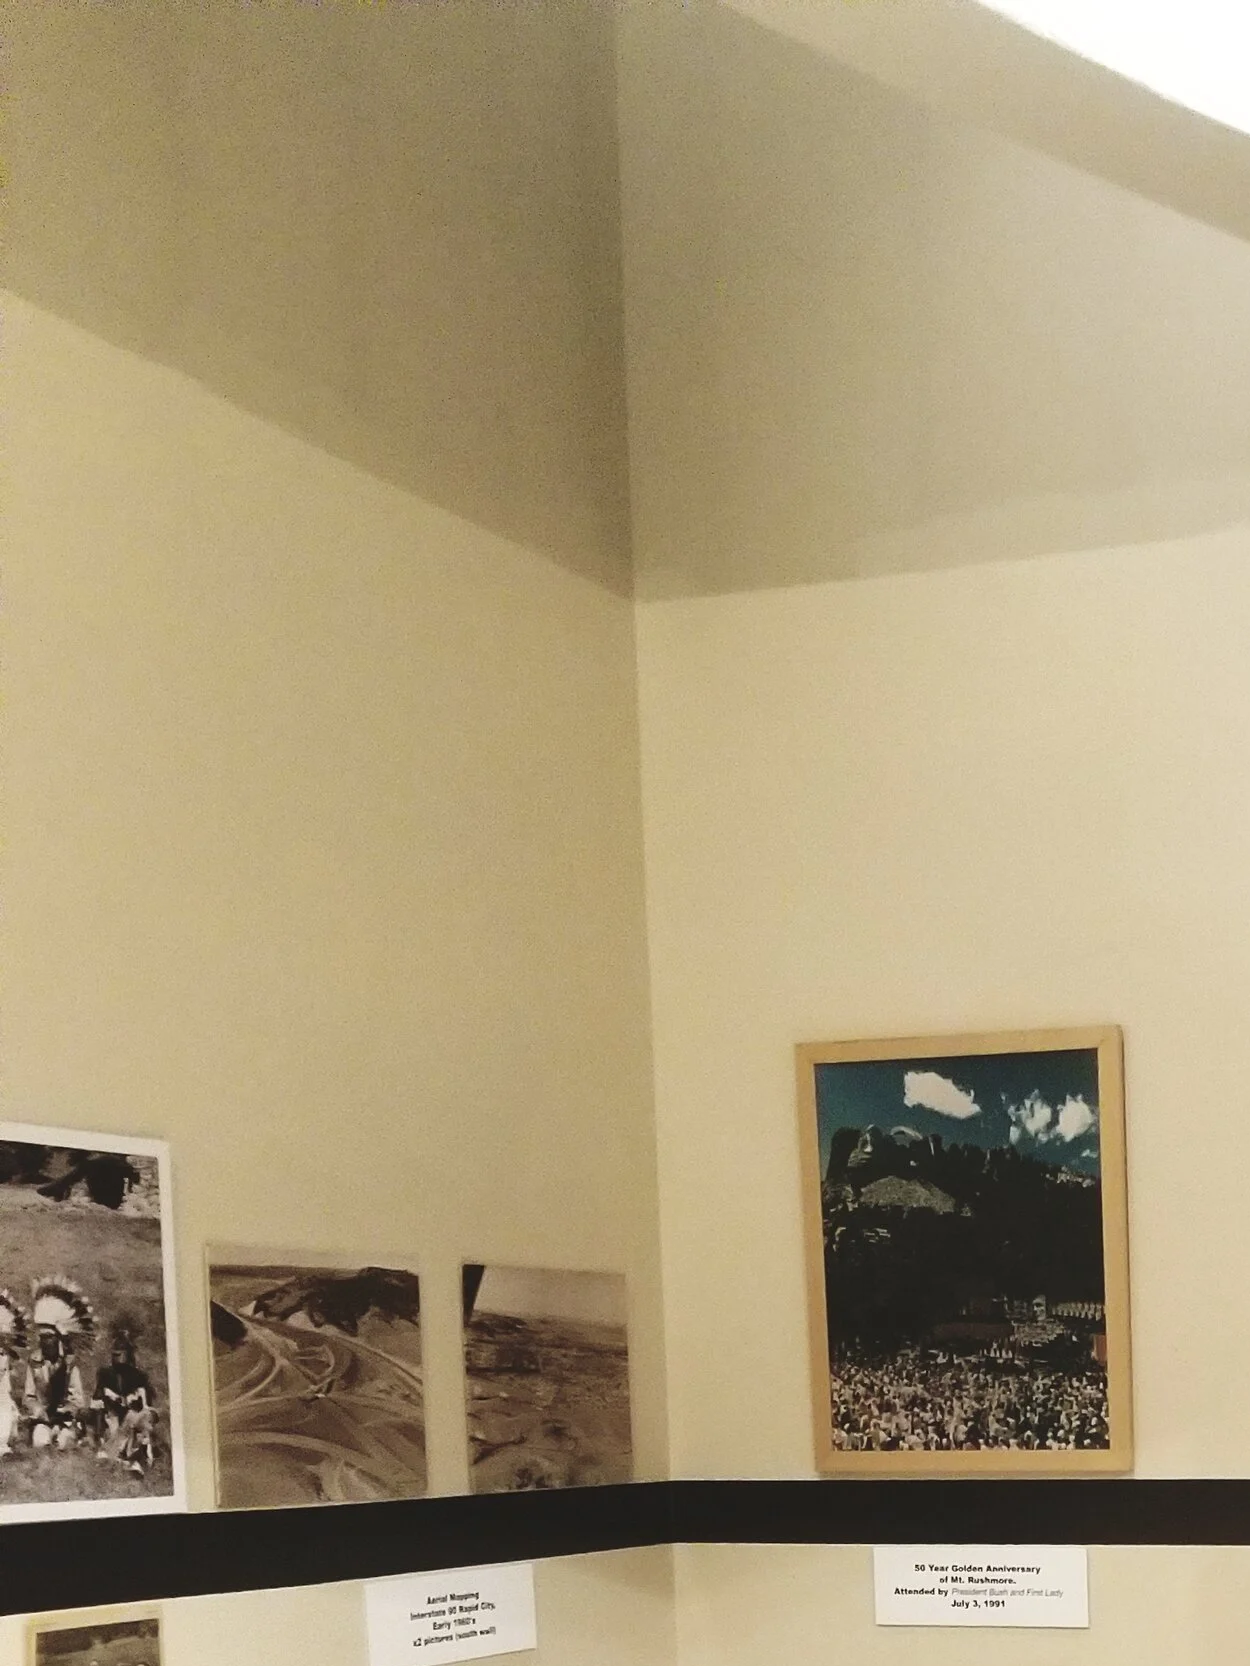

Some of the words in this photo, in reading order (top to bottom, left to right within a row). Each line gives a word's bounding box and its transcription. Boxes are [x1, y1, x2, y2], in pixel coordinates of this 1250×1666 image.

[914, 1564, 926, 1573] 50
[928, 1564, 949, 1573] Year
[951, 1564, 983, 1573] Golden
[986, 1564, 1041, 1575] Anniversary
[939, 1576, 949, 1584] of
[951, 1576, 965, 1584] Mt.
[968, 1576, 1017, 1585] Rushmore.
[894, 1587, 935, 1596] Attended
[938, 1588, 949, 1598] by
[1010, 1588, 1025, 1597] and
[951, 1600, 970, 1609] July
[972, 1600, 981, 1609] 3,
[984, 1600, 1006, 1608] 1991
[433, 1621, 451, 1631] Early
